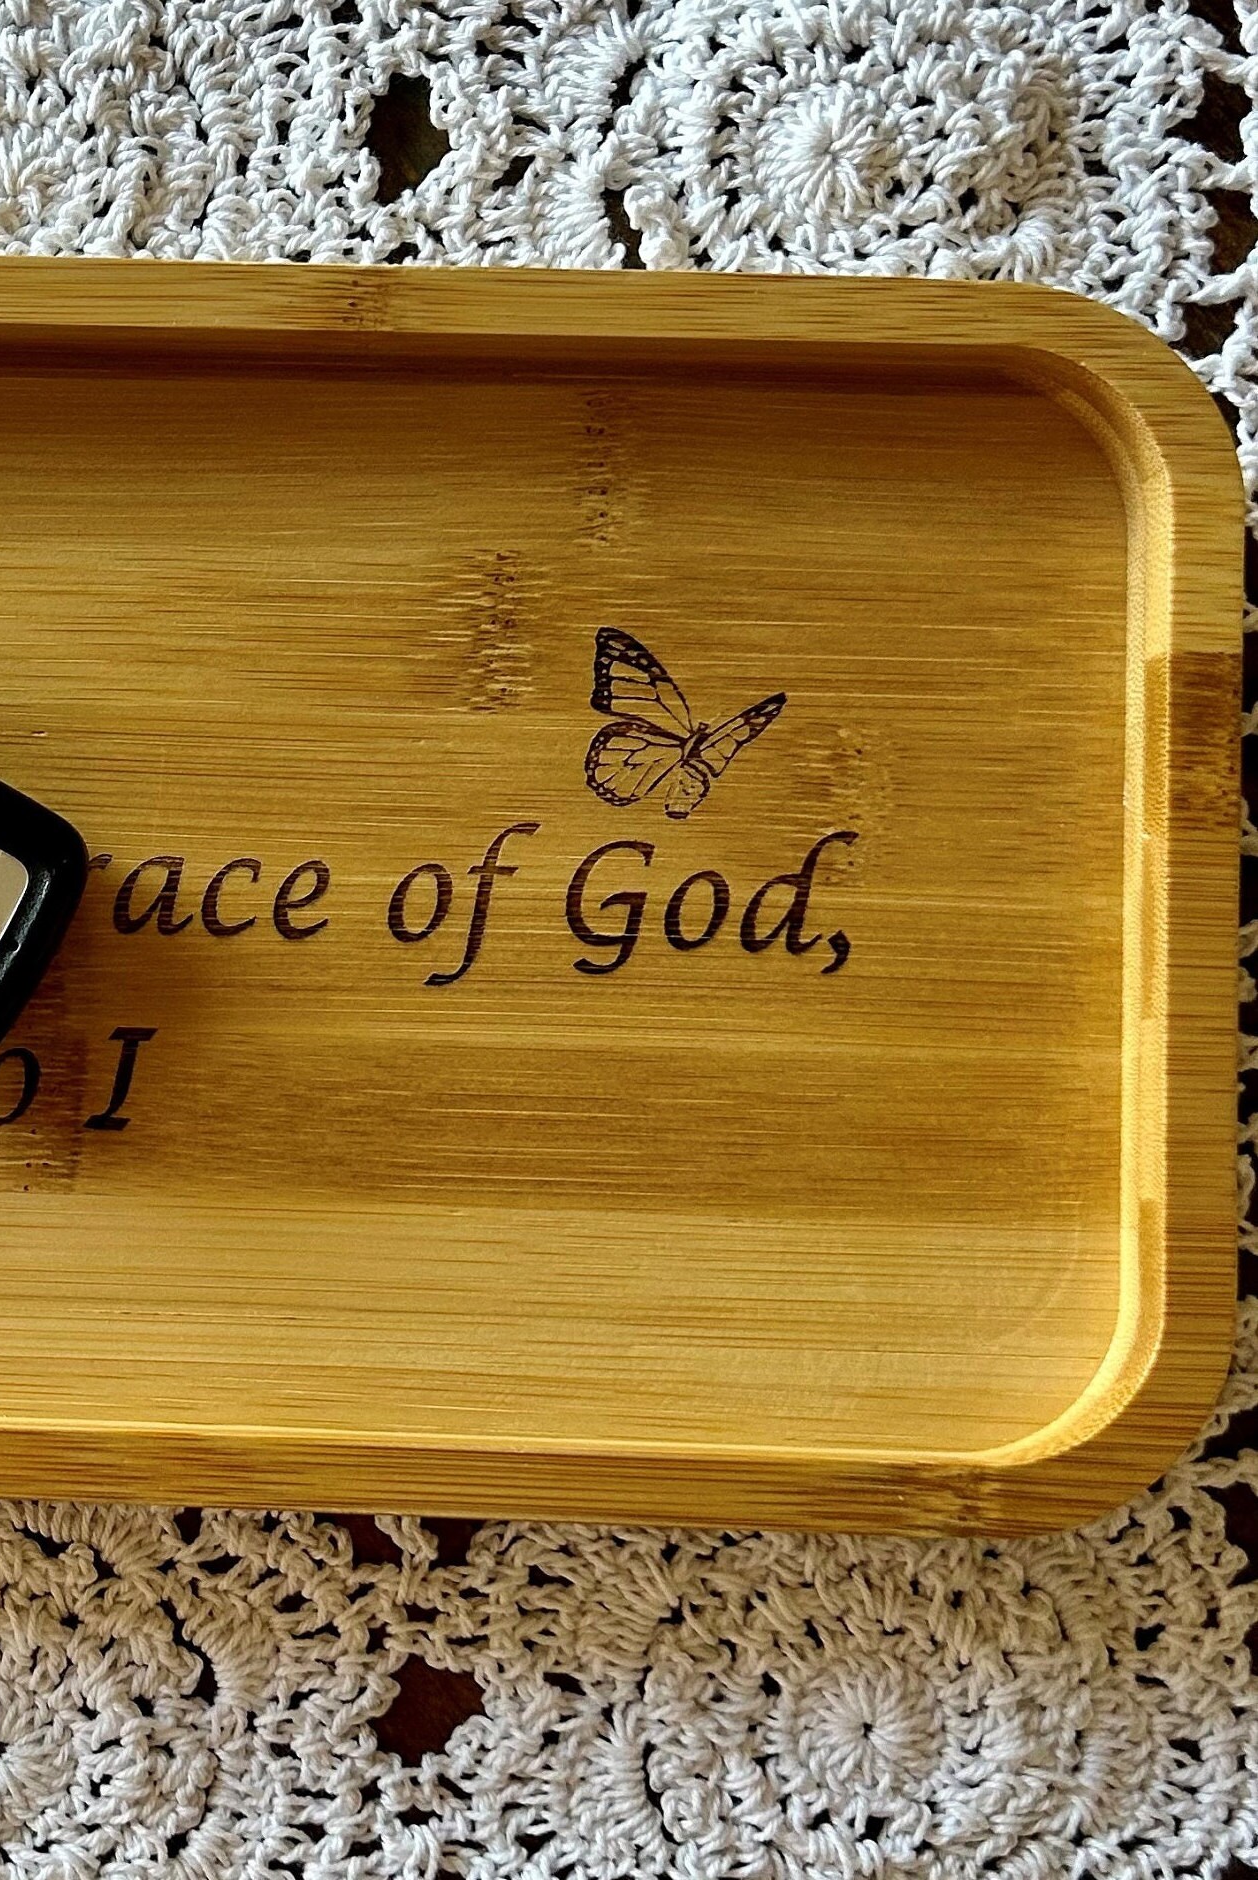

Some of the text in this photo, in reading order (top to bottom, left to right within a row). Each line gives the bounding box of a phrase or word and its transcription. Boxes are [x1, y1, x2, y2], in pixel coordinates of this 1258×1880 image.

[87, 852, 331, 941] ace
[386, 822, 541, 987] of
[565, 830, 860, 975] God,
[82, 1026, 159, 1131] I
